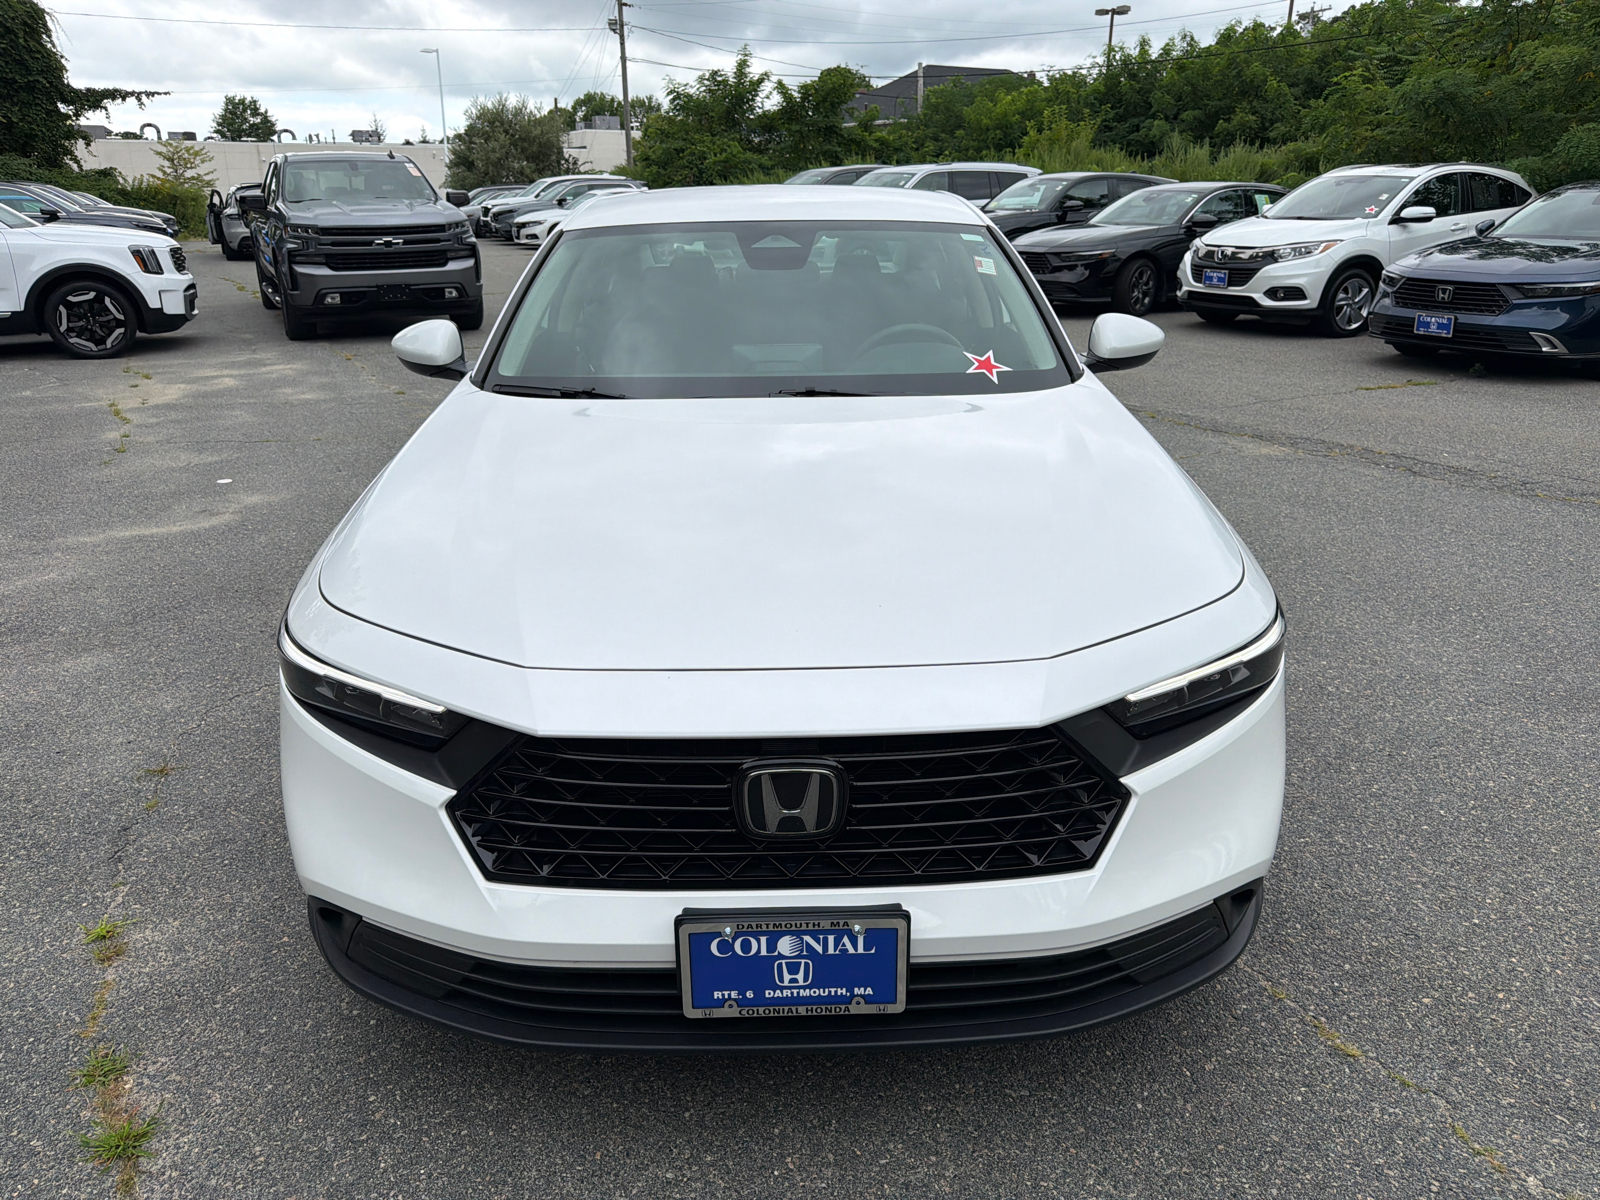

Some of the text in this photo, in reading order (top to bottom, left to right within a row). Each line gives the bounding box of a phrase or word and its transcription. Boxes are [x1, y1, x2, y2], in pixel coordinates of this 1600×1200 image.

[736, 922, 826, 931] DARTMOUTH,
[710, 934, 876, 957] COLONIAL
[713, 986, 873, 999] RTE. 6 DARTMOUTH, MA
[738, 1005, 851, 1016] COLONIAL HONDA
